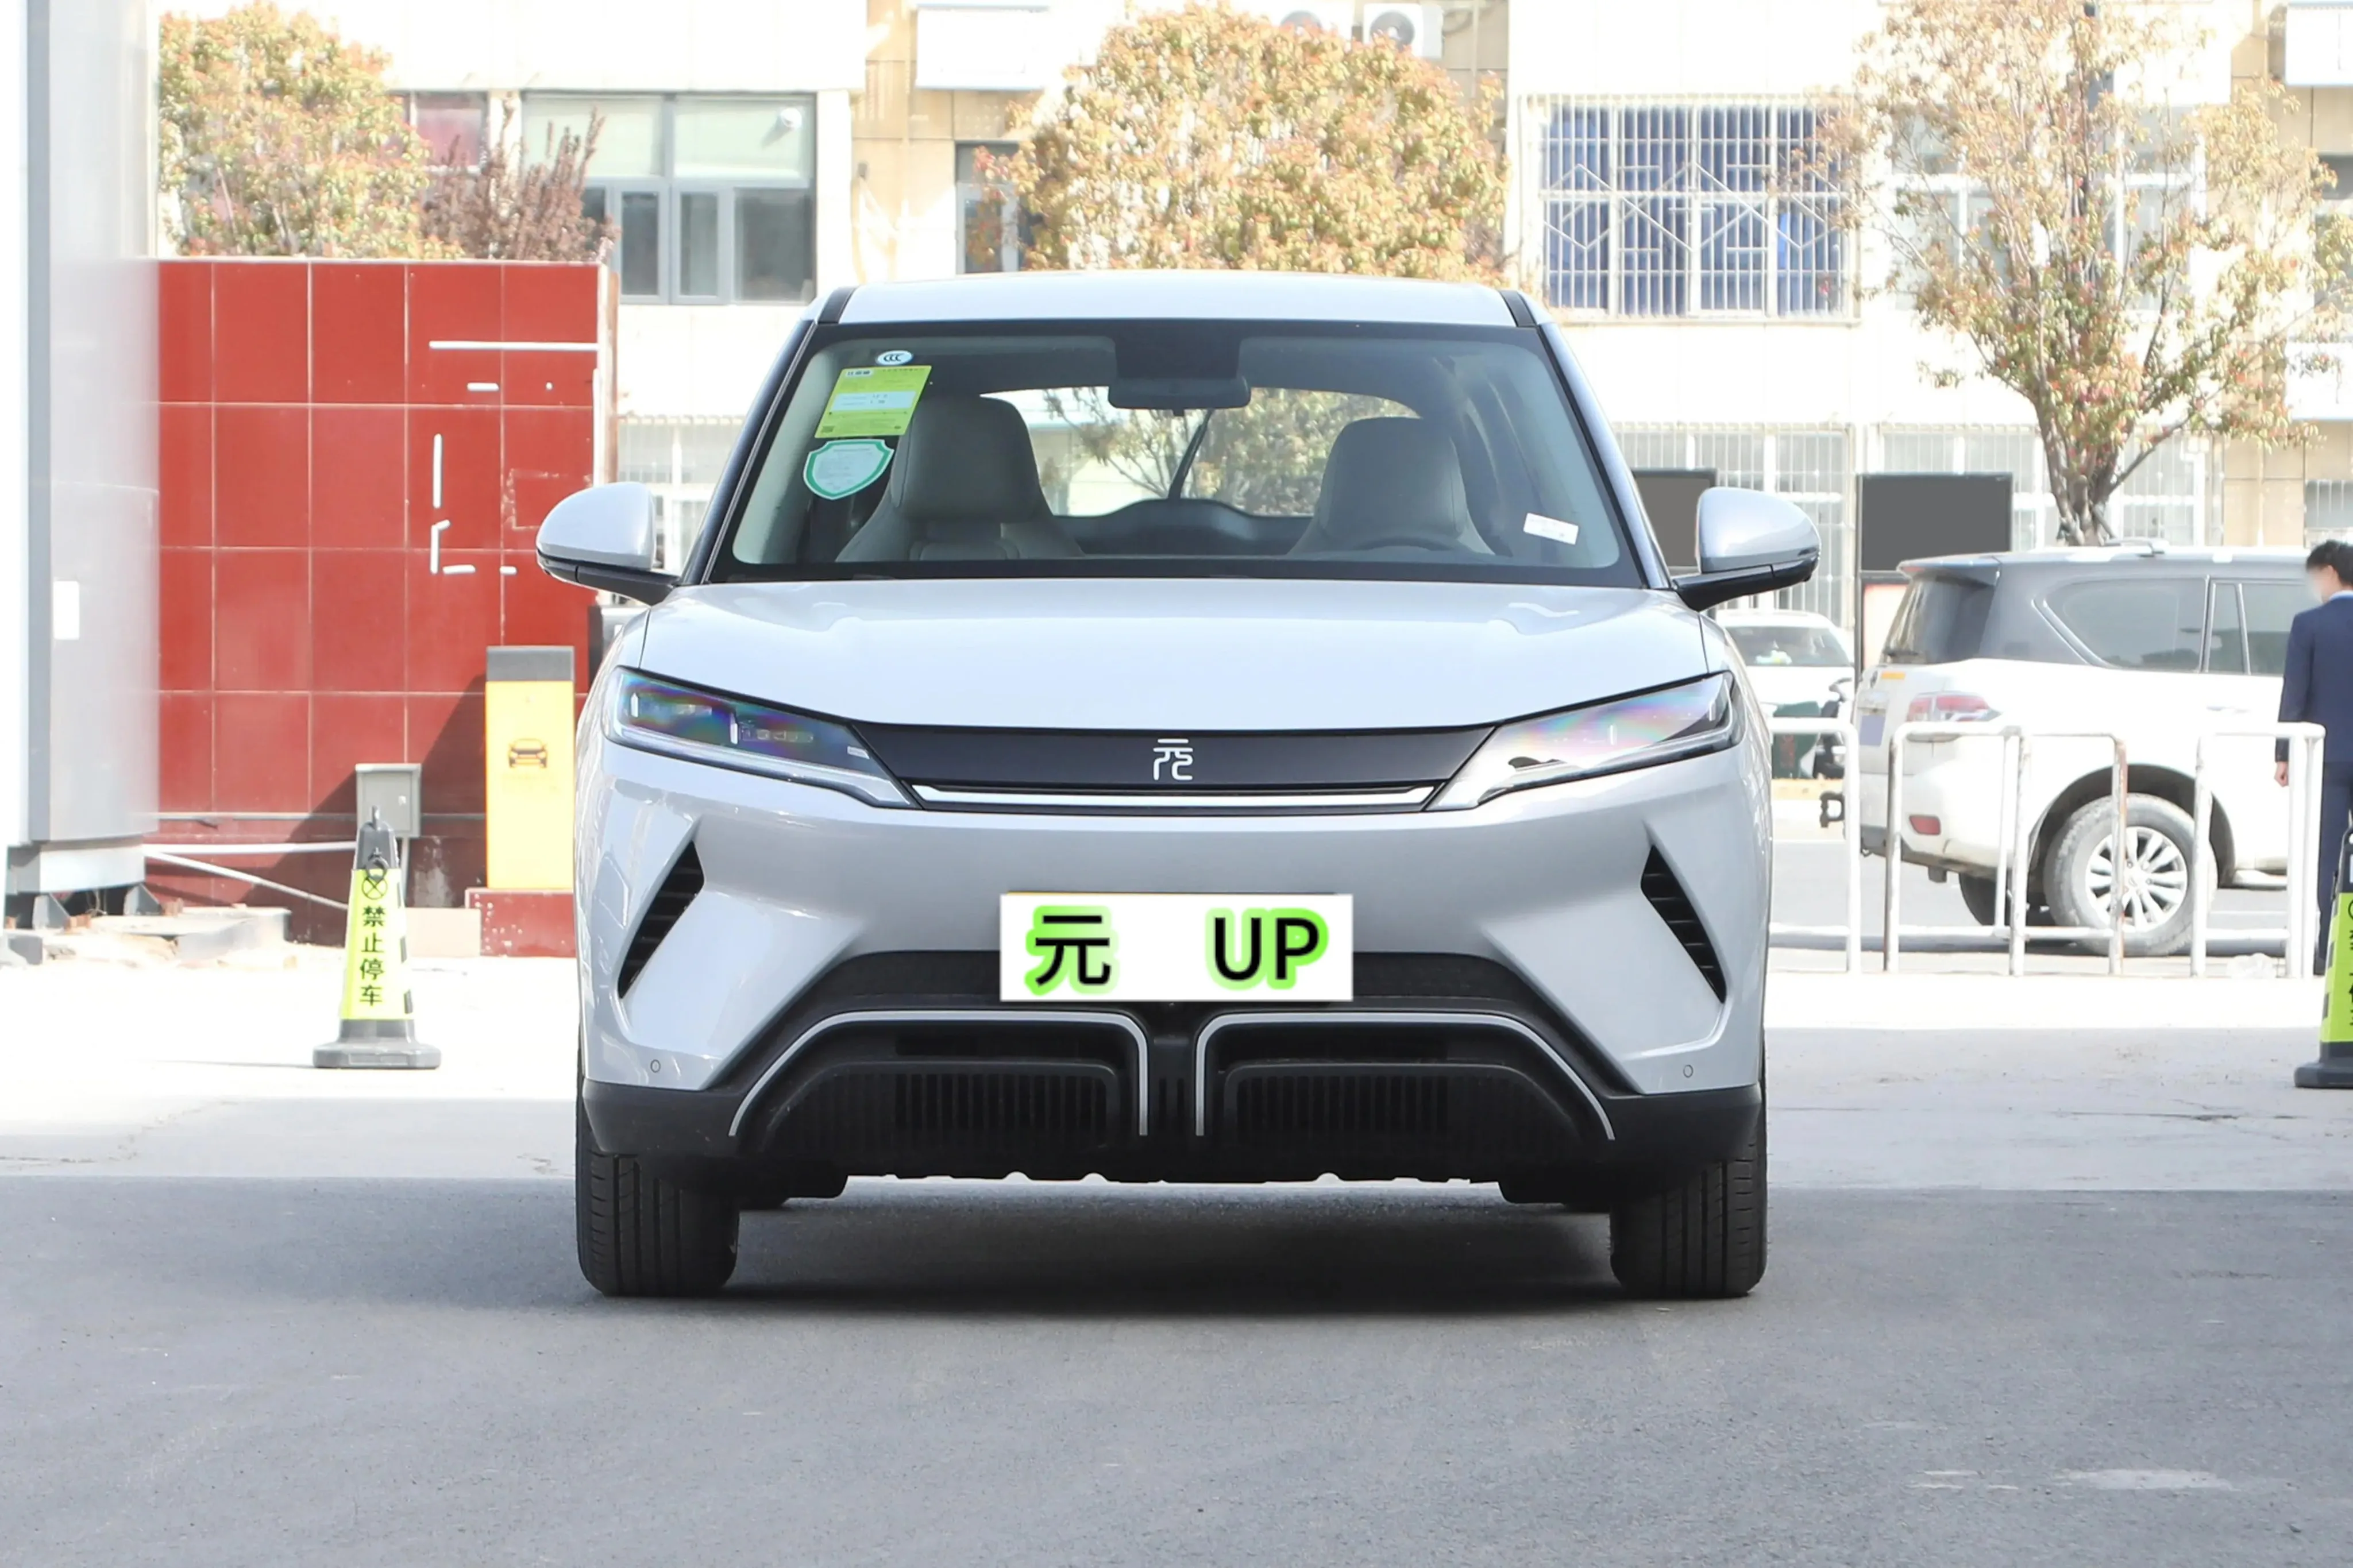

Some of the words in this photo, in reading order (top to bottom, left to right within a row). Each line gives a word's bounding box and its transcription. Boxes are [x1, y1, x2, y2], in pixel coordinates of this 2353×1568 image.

[884, 353, 904, 362] CCC
[1153, 738, 1194, 781] 元
[359, 906, 385, 1007] 禁止停车
